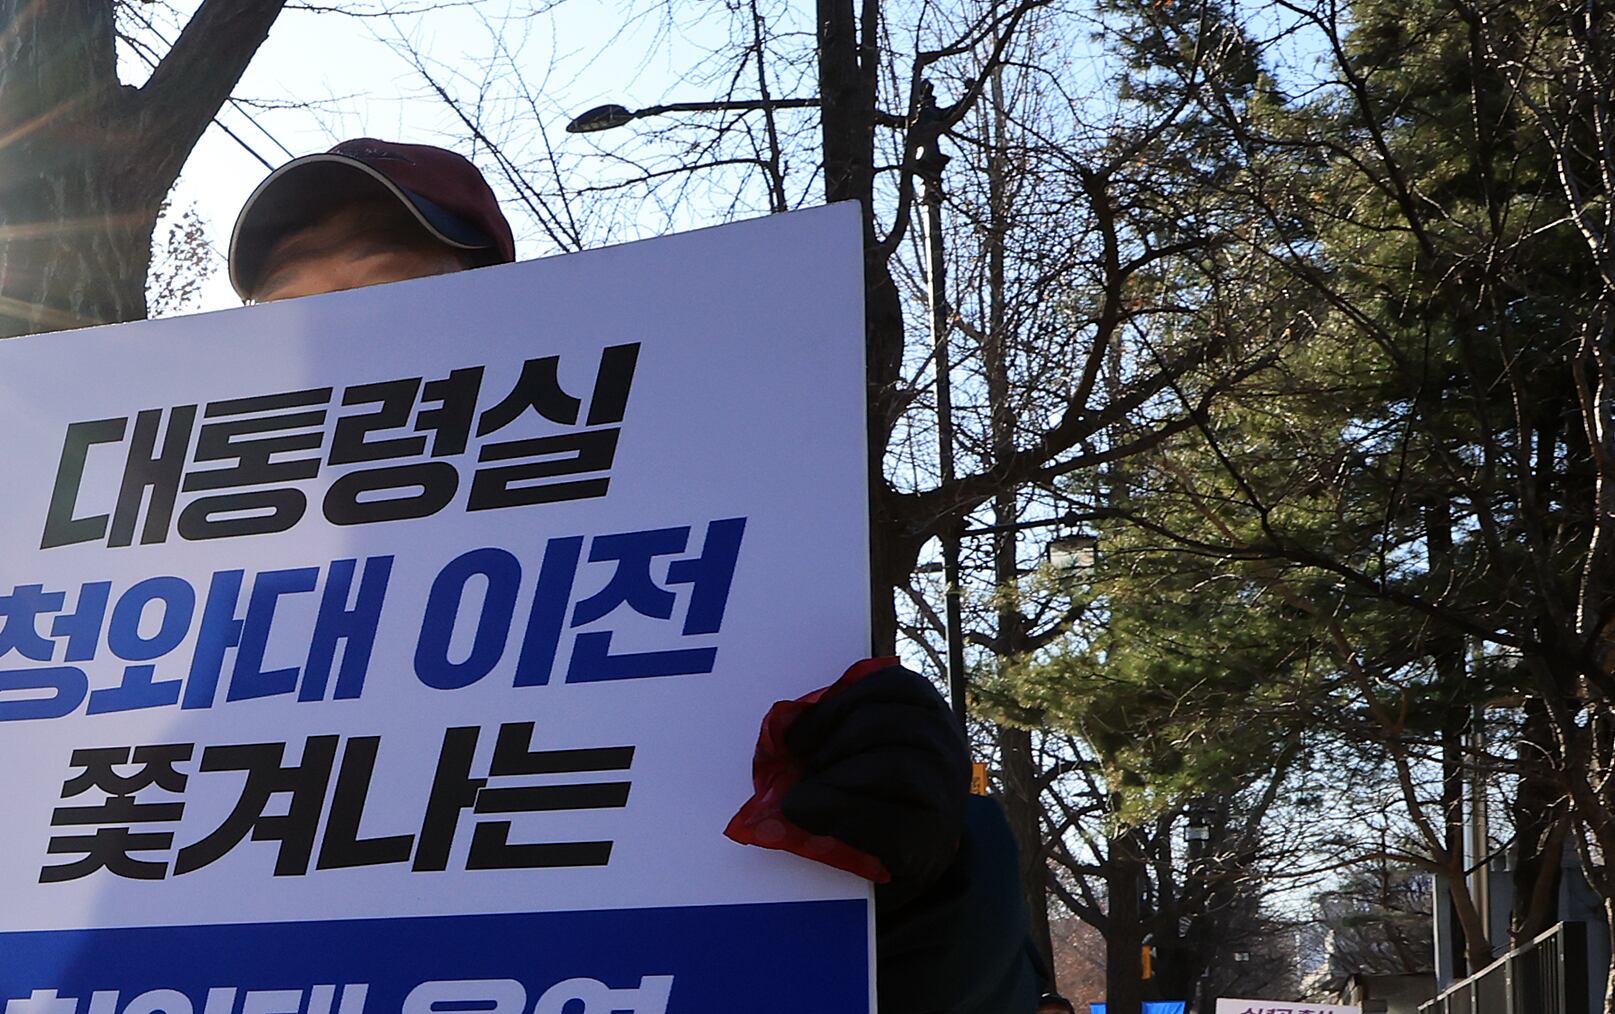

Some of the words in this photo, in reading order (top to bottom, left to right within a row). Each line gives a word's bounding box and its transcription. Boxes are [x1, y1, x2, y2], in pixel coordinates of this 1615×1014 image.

[39, 341, 641, 550] 대통령실
[413, 516, 746, 691] 이전
[39, 721, 635, 883] 쫓겨나는
